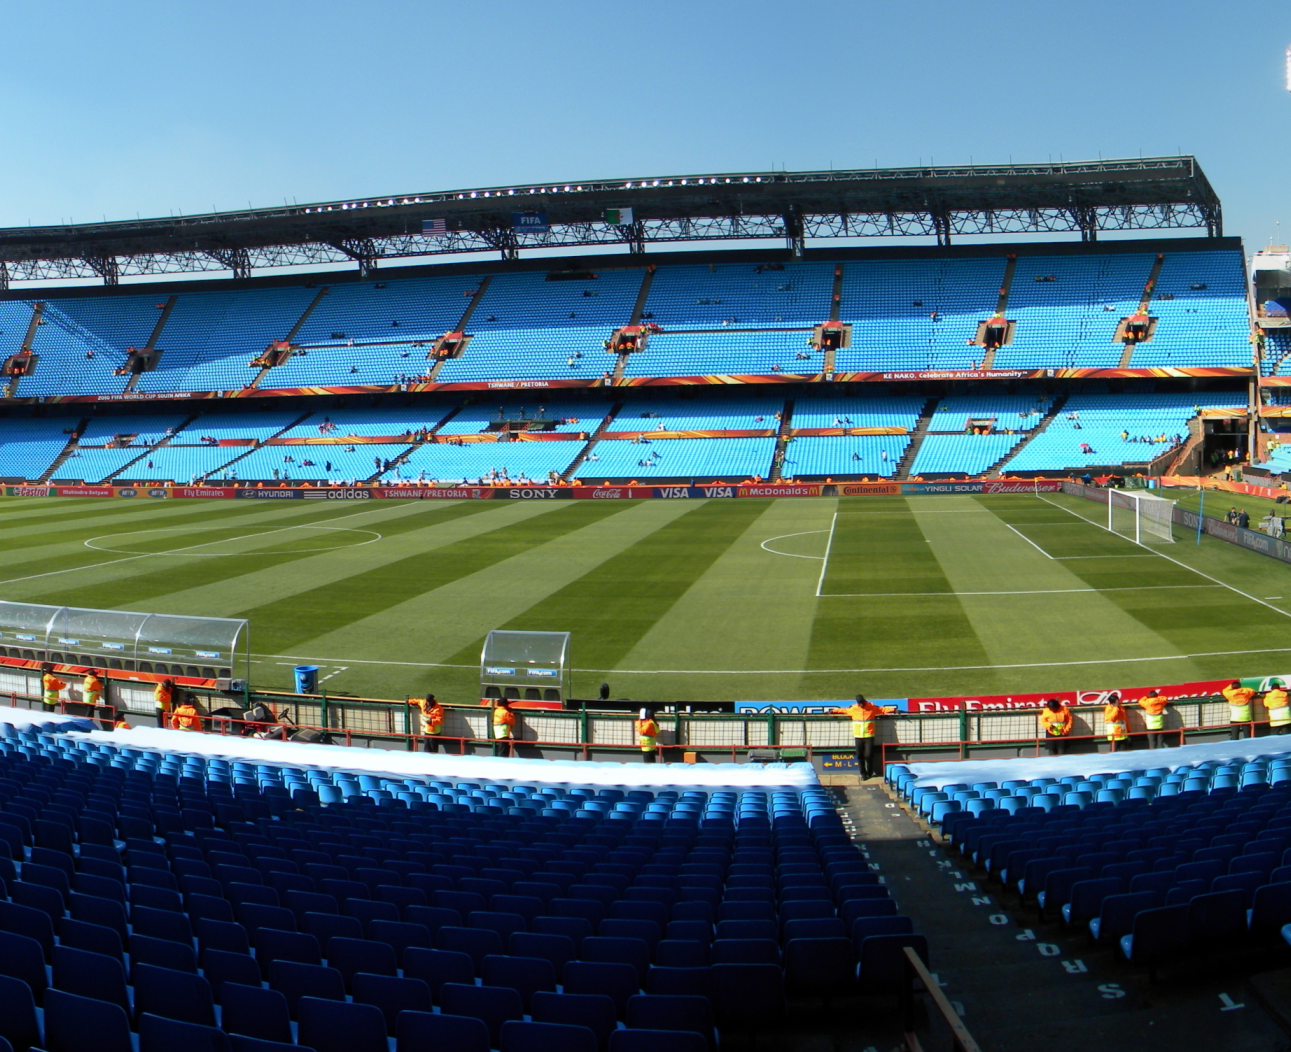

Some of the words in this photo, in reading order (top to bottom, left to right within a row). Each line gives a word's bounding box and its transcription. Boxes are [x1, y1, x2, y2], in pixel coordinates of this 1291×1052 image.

[521, 216, 541, 224] FIFA
[20, 487, 48, 497] Castrol
[660, 487, 689, 498] VISA
[704, 486, 733, 498] VISA
[750, 486, 808, 496] McDonald's
[843, 486, 889, 494] Continental
[954, 484, 982, 492] SOLAR
[985, 481, 1055, 494] Budweiser
[184, 490, 194, 498] Fly
[196, 488, 224, 497] Emirates
[258, 490, 294, 498] HYUNDAI
[328, 488, 370, 499] adidas
[510, 489, 558, 498] SONY
[936, 860, 952, 868] K
[948, 871, 962, 879] L
[954, 882, 976, 892] M
[971, 896, 991, 906] N
[989, 914, 1008, 925] O
[1016, 929, 1036, 941] P
[1036, 942, 1060, 956] Q
[1062, 959, 1088, 974] R
[1097, 983, 1126, 999] S
[1218, 992, 1246, 1012] T
